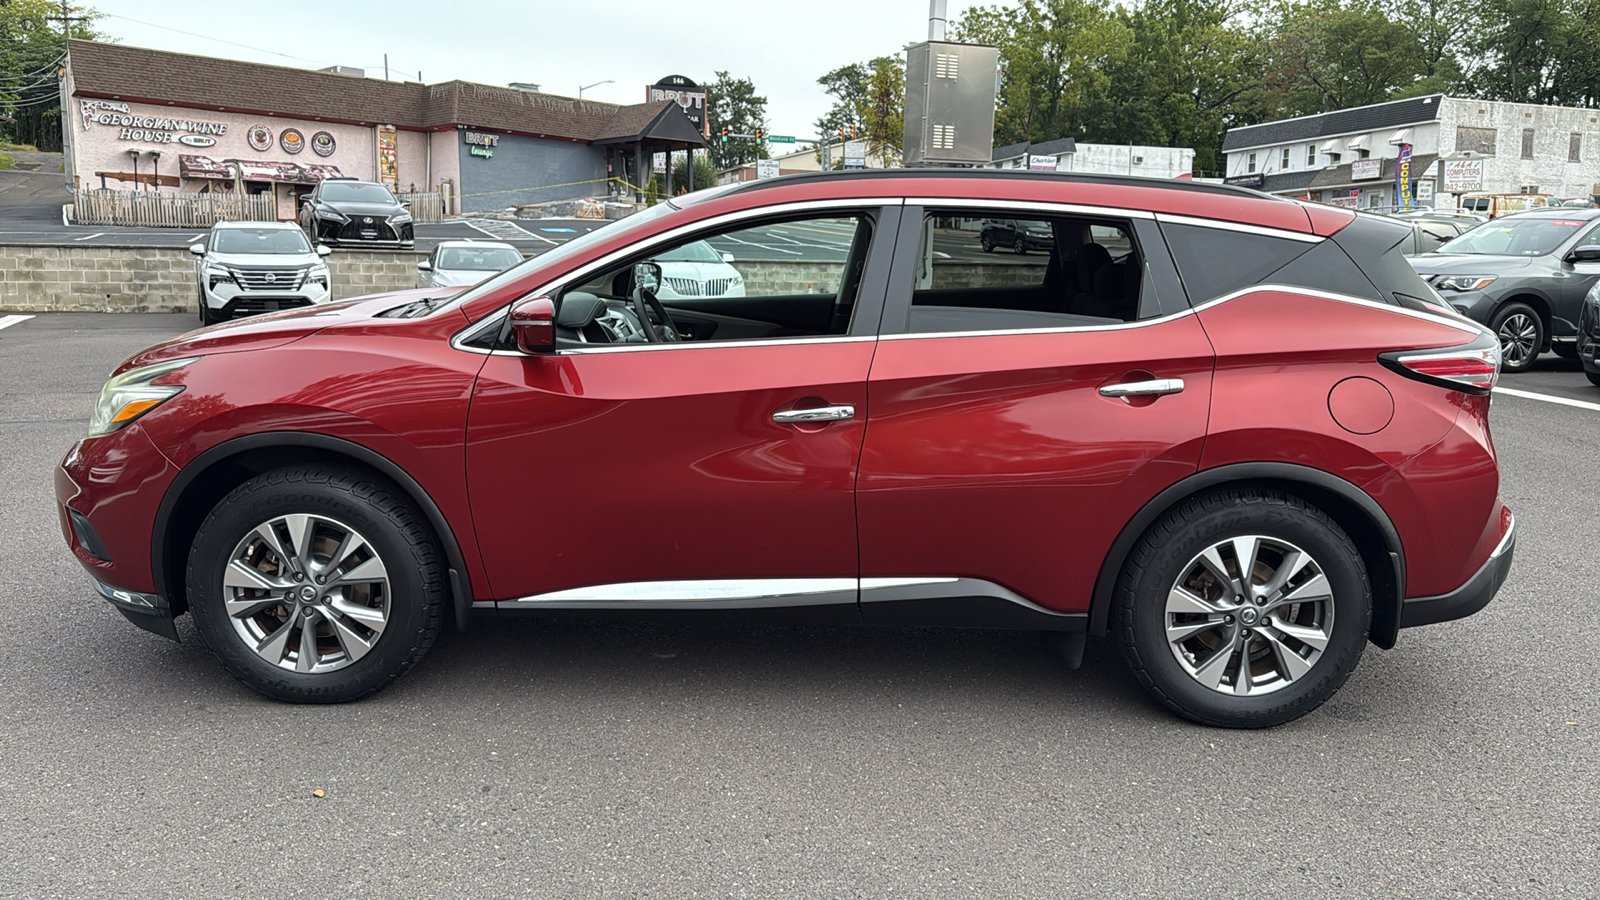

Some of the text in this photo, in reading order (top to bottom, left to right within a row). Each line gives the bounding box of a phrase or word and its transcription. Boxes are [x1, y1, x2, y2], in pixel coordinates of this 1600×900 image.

[673, 77, 685, 85] 146
[651, 88, 705, 109] BRUT
[99, 113, 228, 135] GEORGIAN WINE
[119, 128, 173, 143] HOUSE
[465, 131, 500, 147] BRUT
[471, 145, 494, 159] Lounge
[1446, 168, 1480, 176] COMPUTERS
